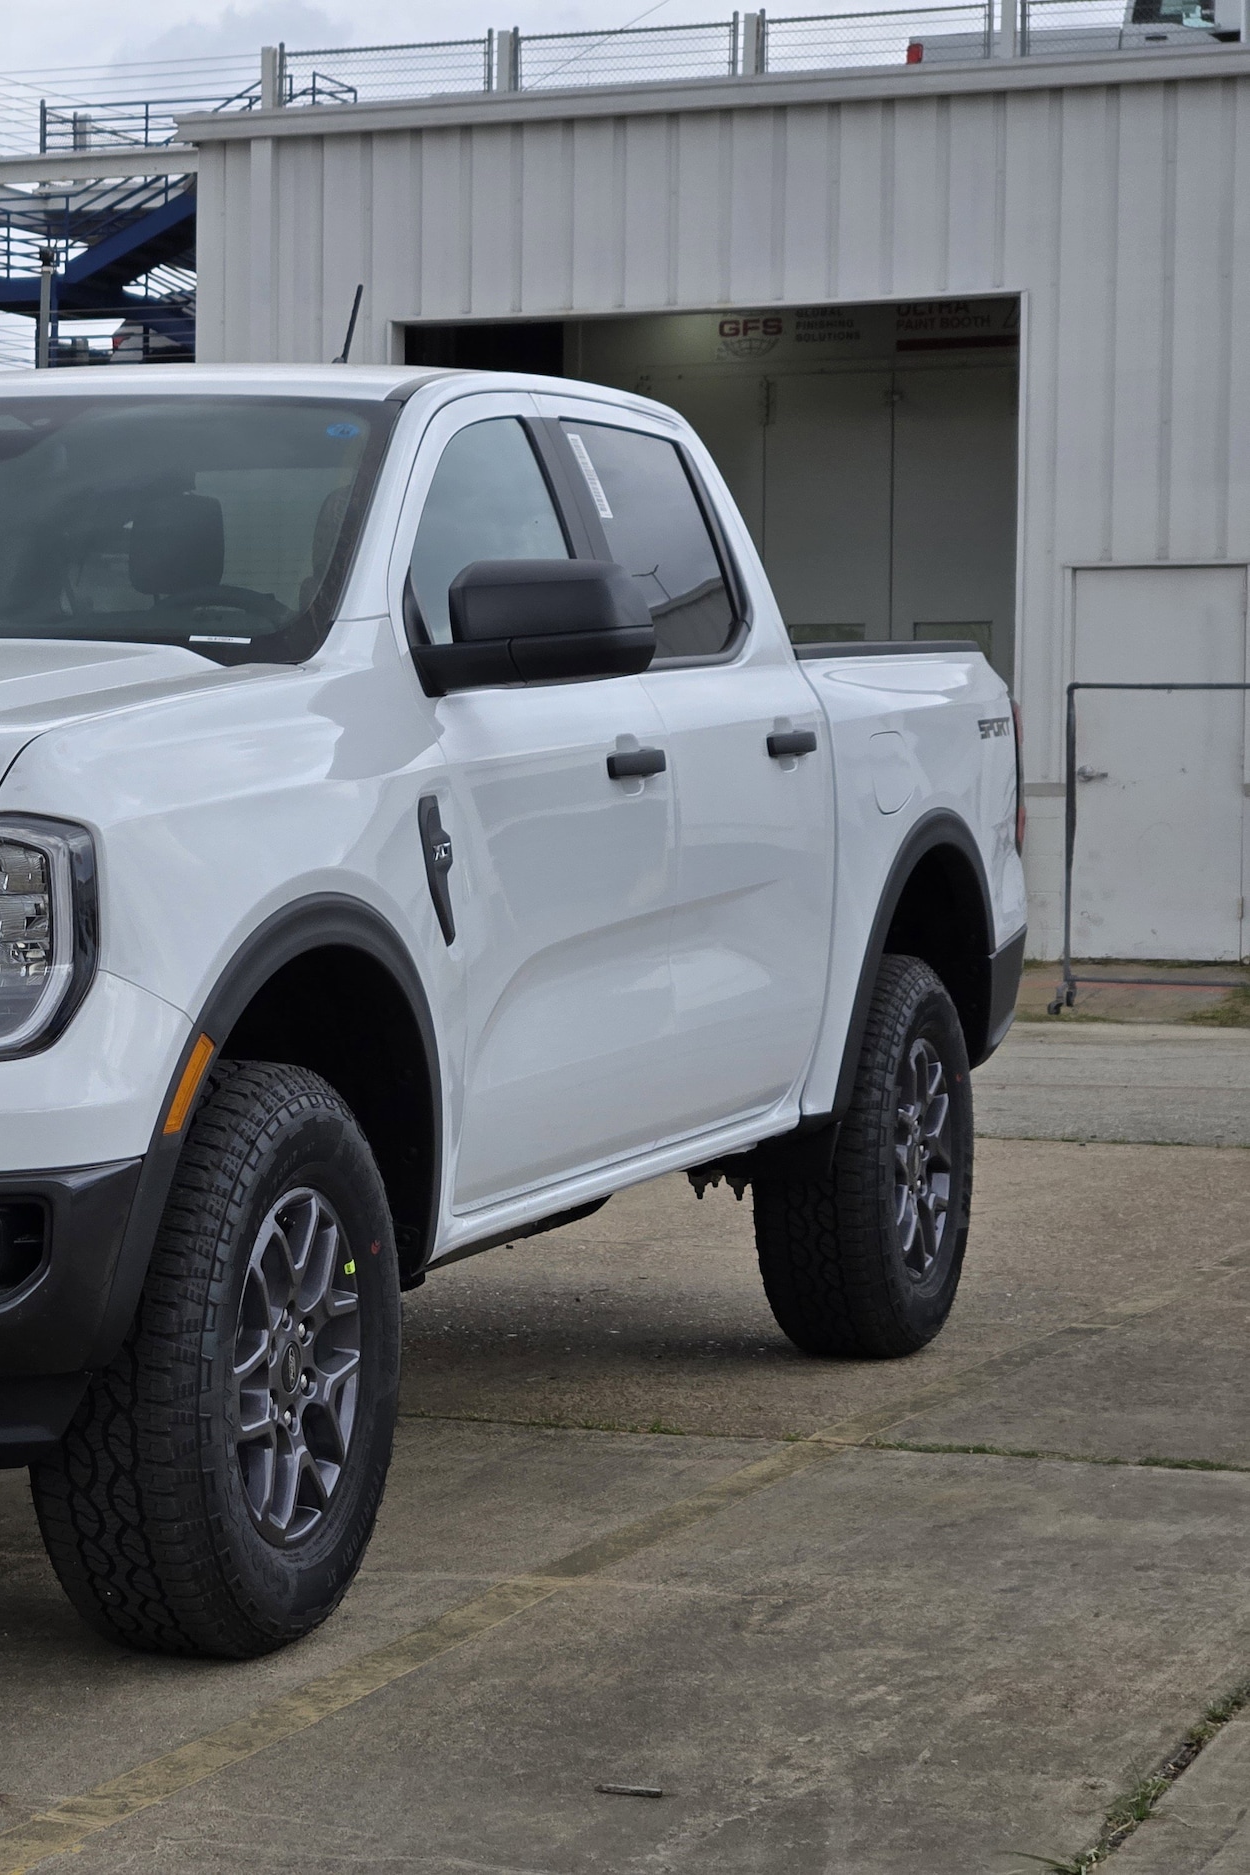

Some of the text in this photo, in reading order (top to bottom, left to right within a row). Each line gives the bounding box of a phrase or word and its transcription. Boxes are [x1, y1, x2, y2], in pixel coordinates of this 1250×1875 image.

[718, 317, 783, 338] GFS
[795, 319, 855, 331] FINISHING
[896, 314, 991, 332] PAINT BOOTH
[795, 331, 861, 343] SOLUTIONS
